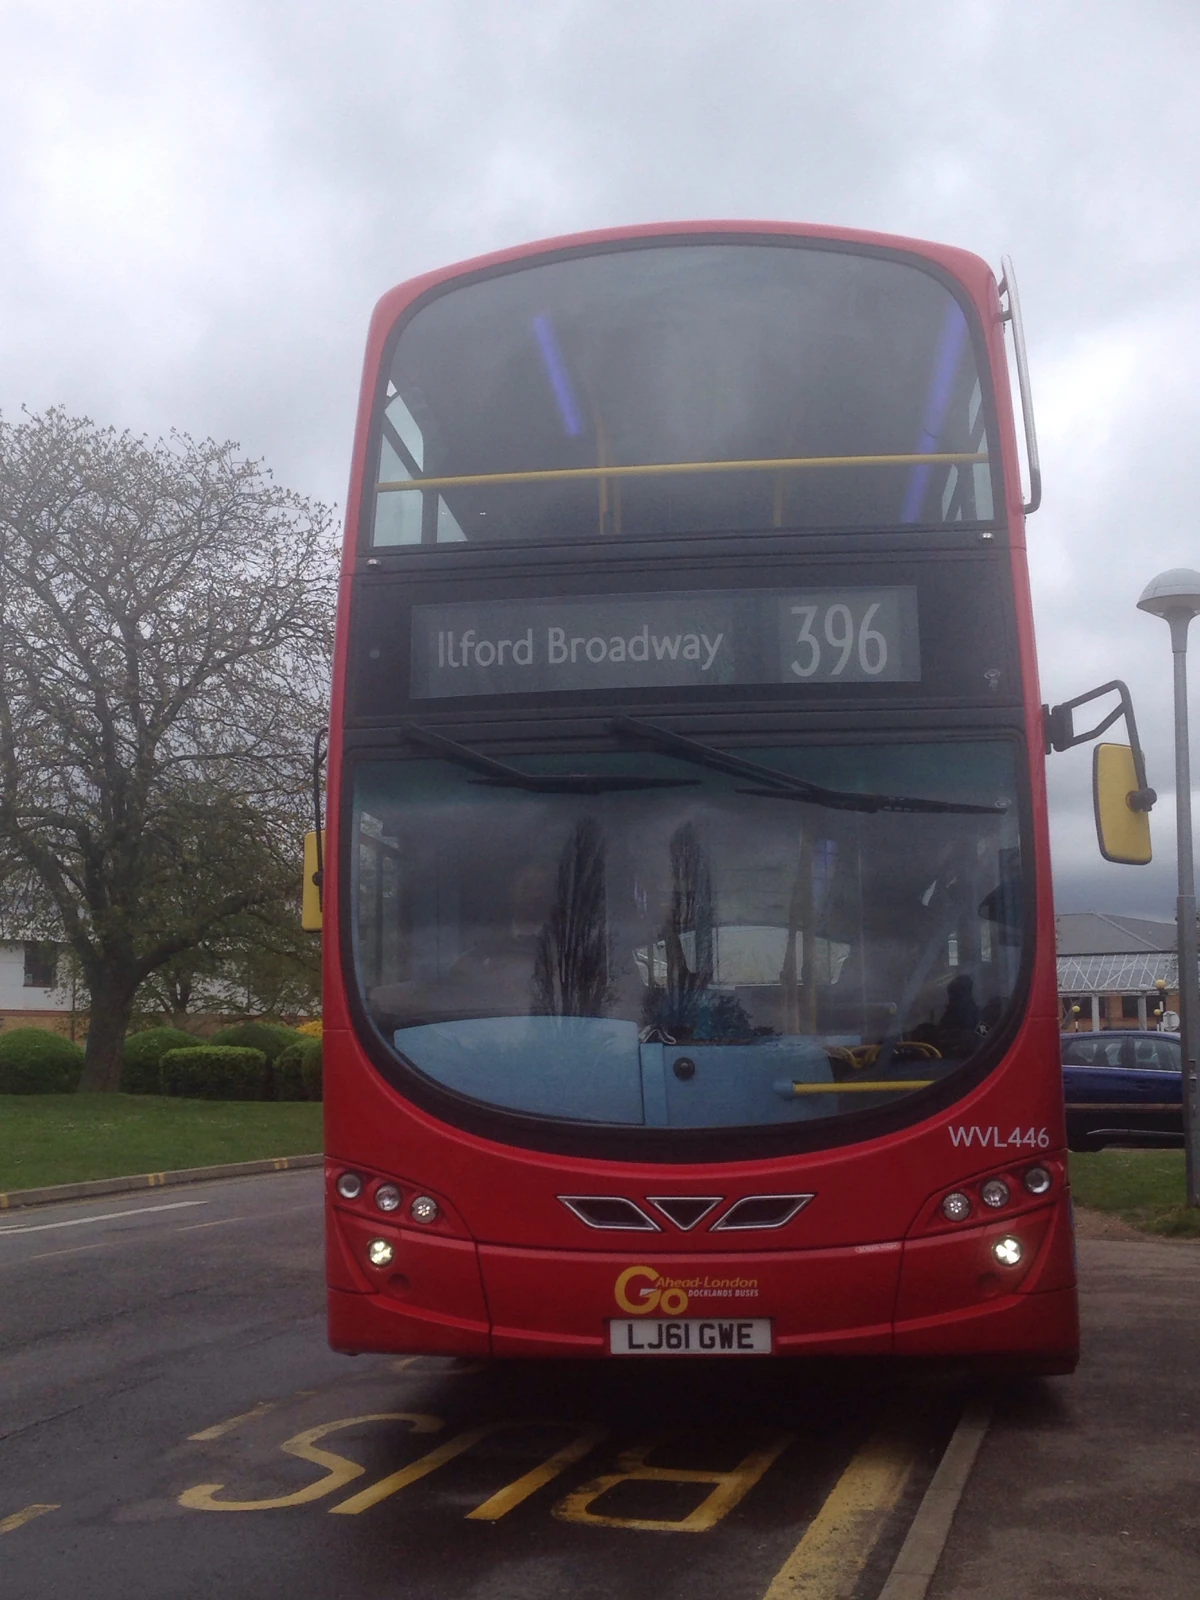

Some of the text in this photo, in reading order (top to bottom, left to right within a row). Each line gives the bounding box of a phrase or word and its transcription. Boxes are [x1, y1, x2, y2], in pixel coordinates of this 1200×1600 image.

[437, 625, 724, 670] Ilford Broadway
[790, 603, 889, 677] 396
[948, 1126, 1050, 1148] WVL446
[614, 1265, 689, 1315] Go
[688, 1289, 759, 1298] DOCKLANDS BUSES
[627, 1323, 754, 1350] LJ61 GWE
[177, 1411, 797, 1533] BUS
